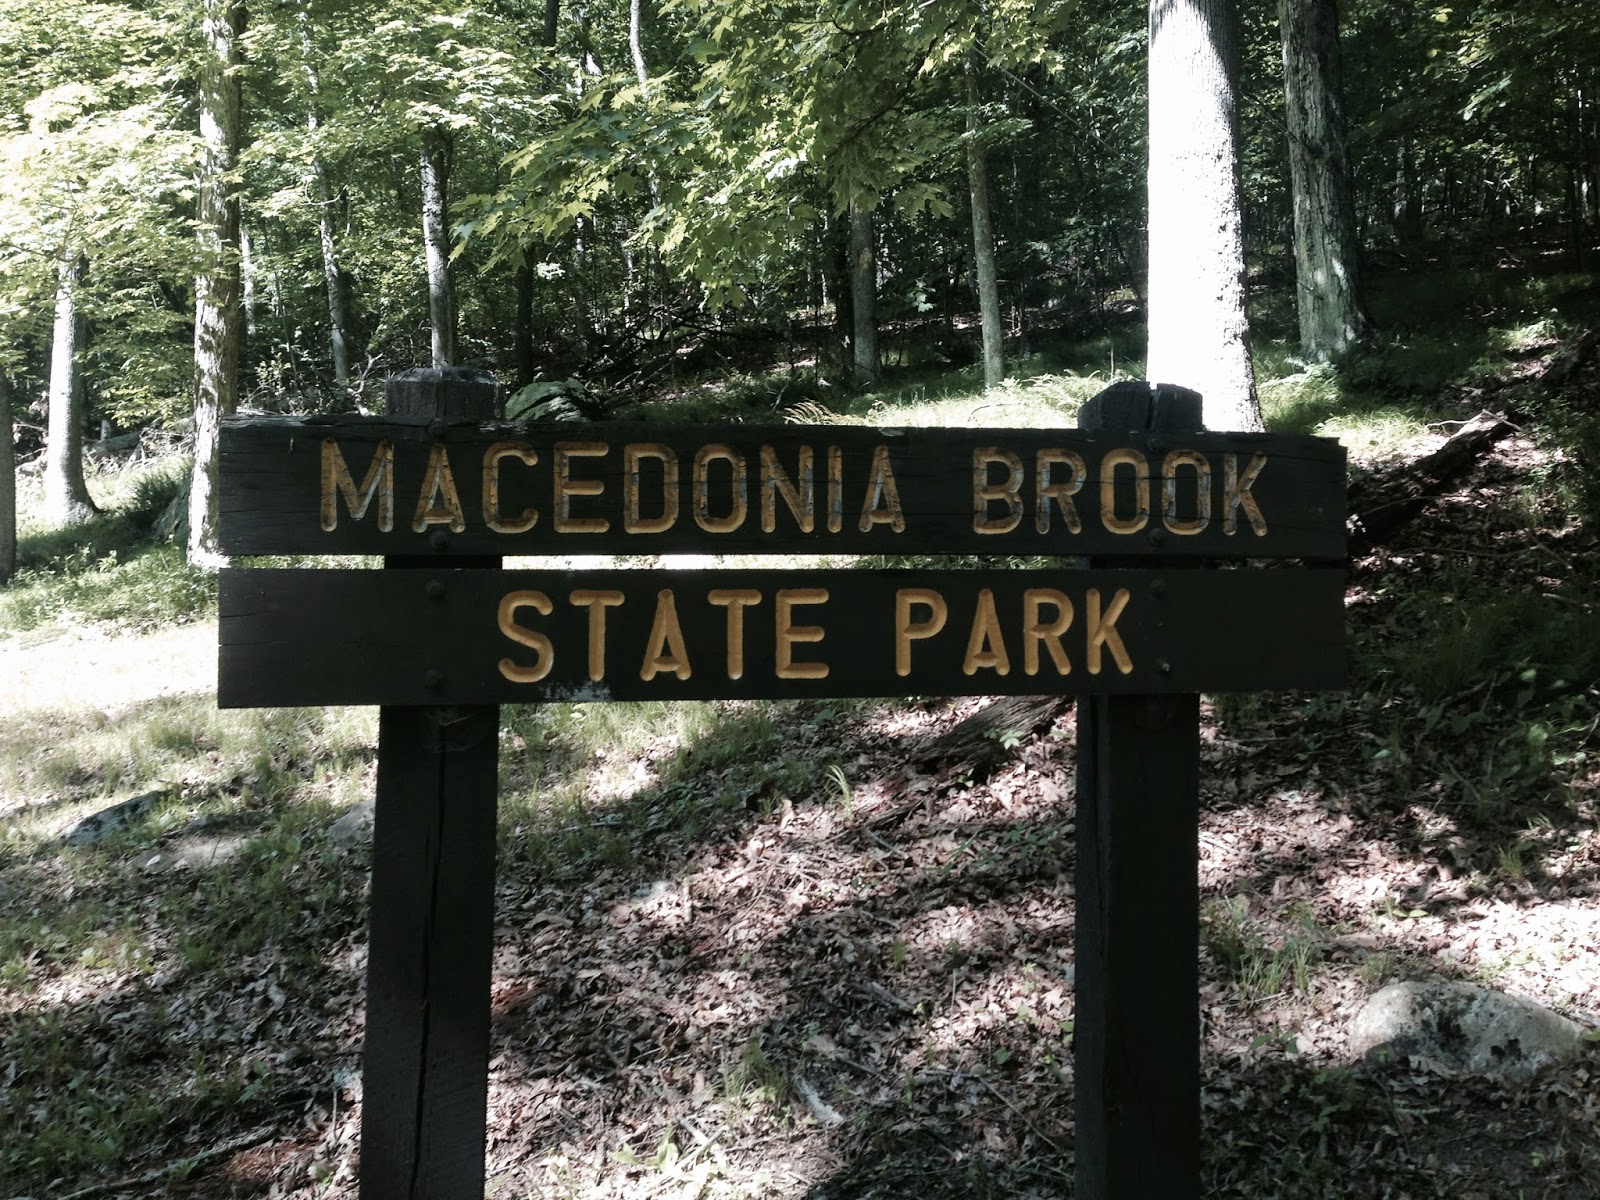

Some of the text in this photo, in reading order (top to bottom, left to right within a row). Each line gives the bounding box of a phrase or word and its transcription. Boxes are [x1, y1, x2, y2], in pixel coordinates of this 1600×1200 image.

[319, 440, 1268, 537] MACEDONIA BROOK
[497, 588, 1134, 684] STATE PARK
